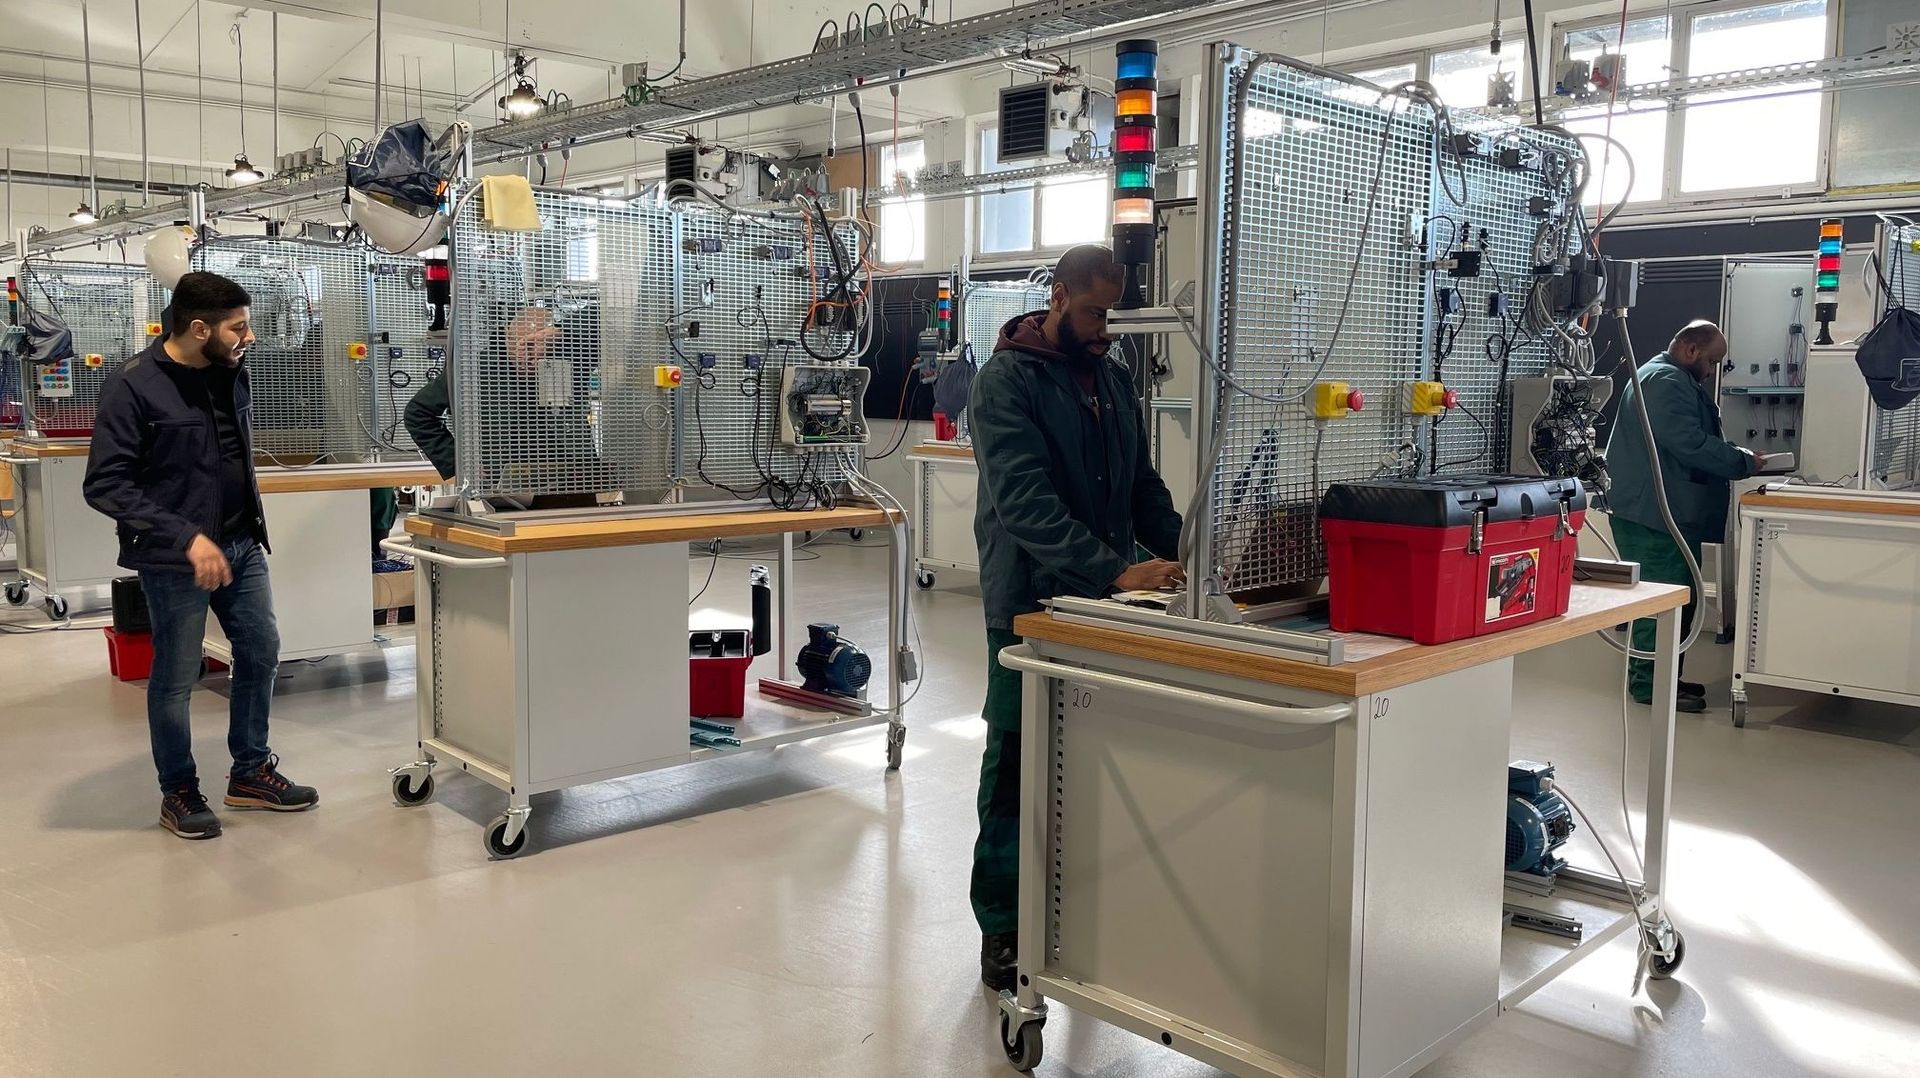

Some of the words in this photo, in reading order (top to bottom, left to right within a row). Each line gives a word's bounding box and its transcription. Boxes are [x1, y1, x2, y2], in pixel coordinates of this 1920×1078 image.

[1767, 530, 1778, 539] 13
[1560, 553, 1571, 574] 20
[1072, 687, 1092, 709] 20
[1373, 696, 1390, 719] 20
